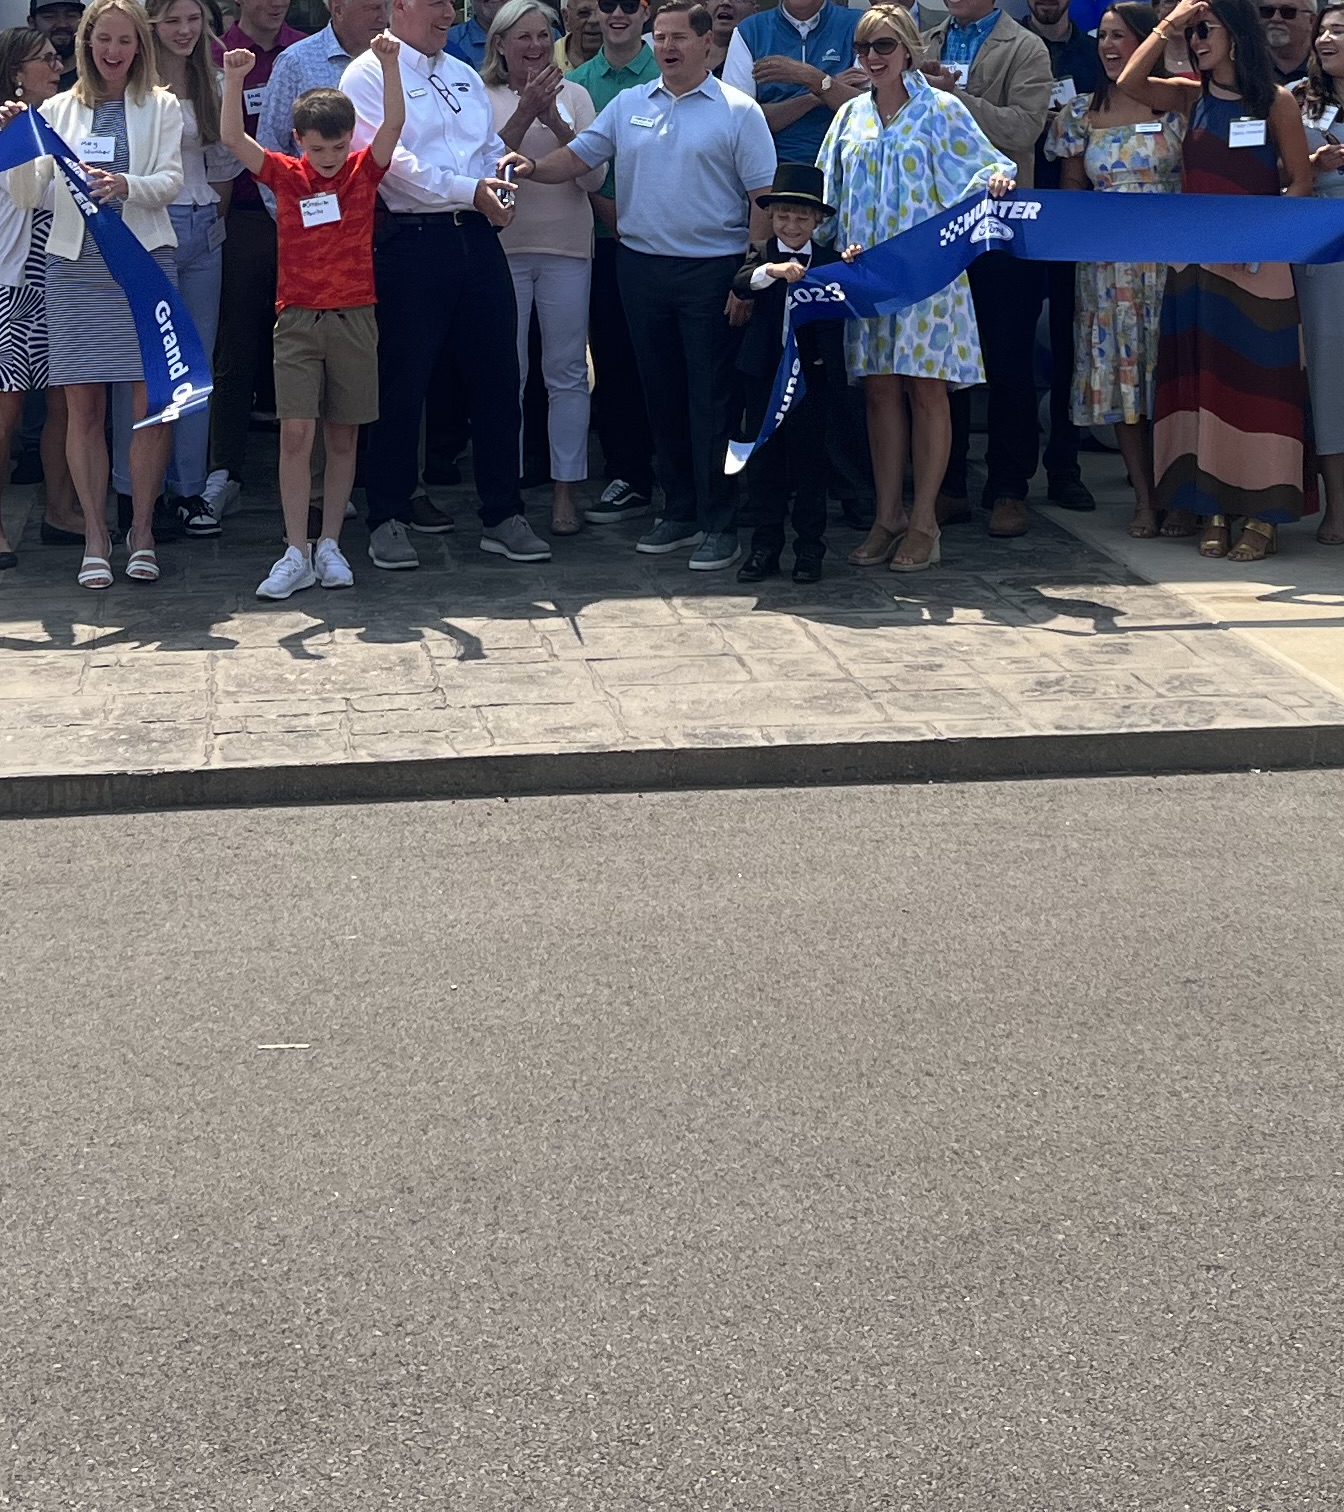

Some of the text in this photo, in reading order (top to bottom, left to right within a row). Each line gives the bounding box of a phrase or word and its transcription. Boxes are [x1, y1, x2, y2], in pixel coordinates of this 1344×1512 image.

[964, 199, 1042, 231] HUNTER
[787, 282, 846, 310] 2023
[155, 300, 190, 381] Grand
